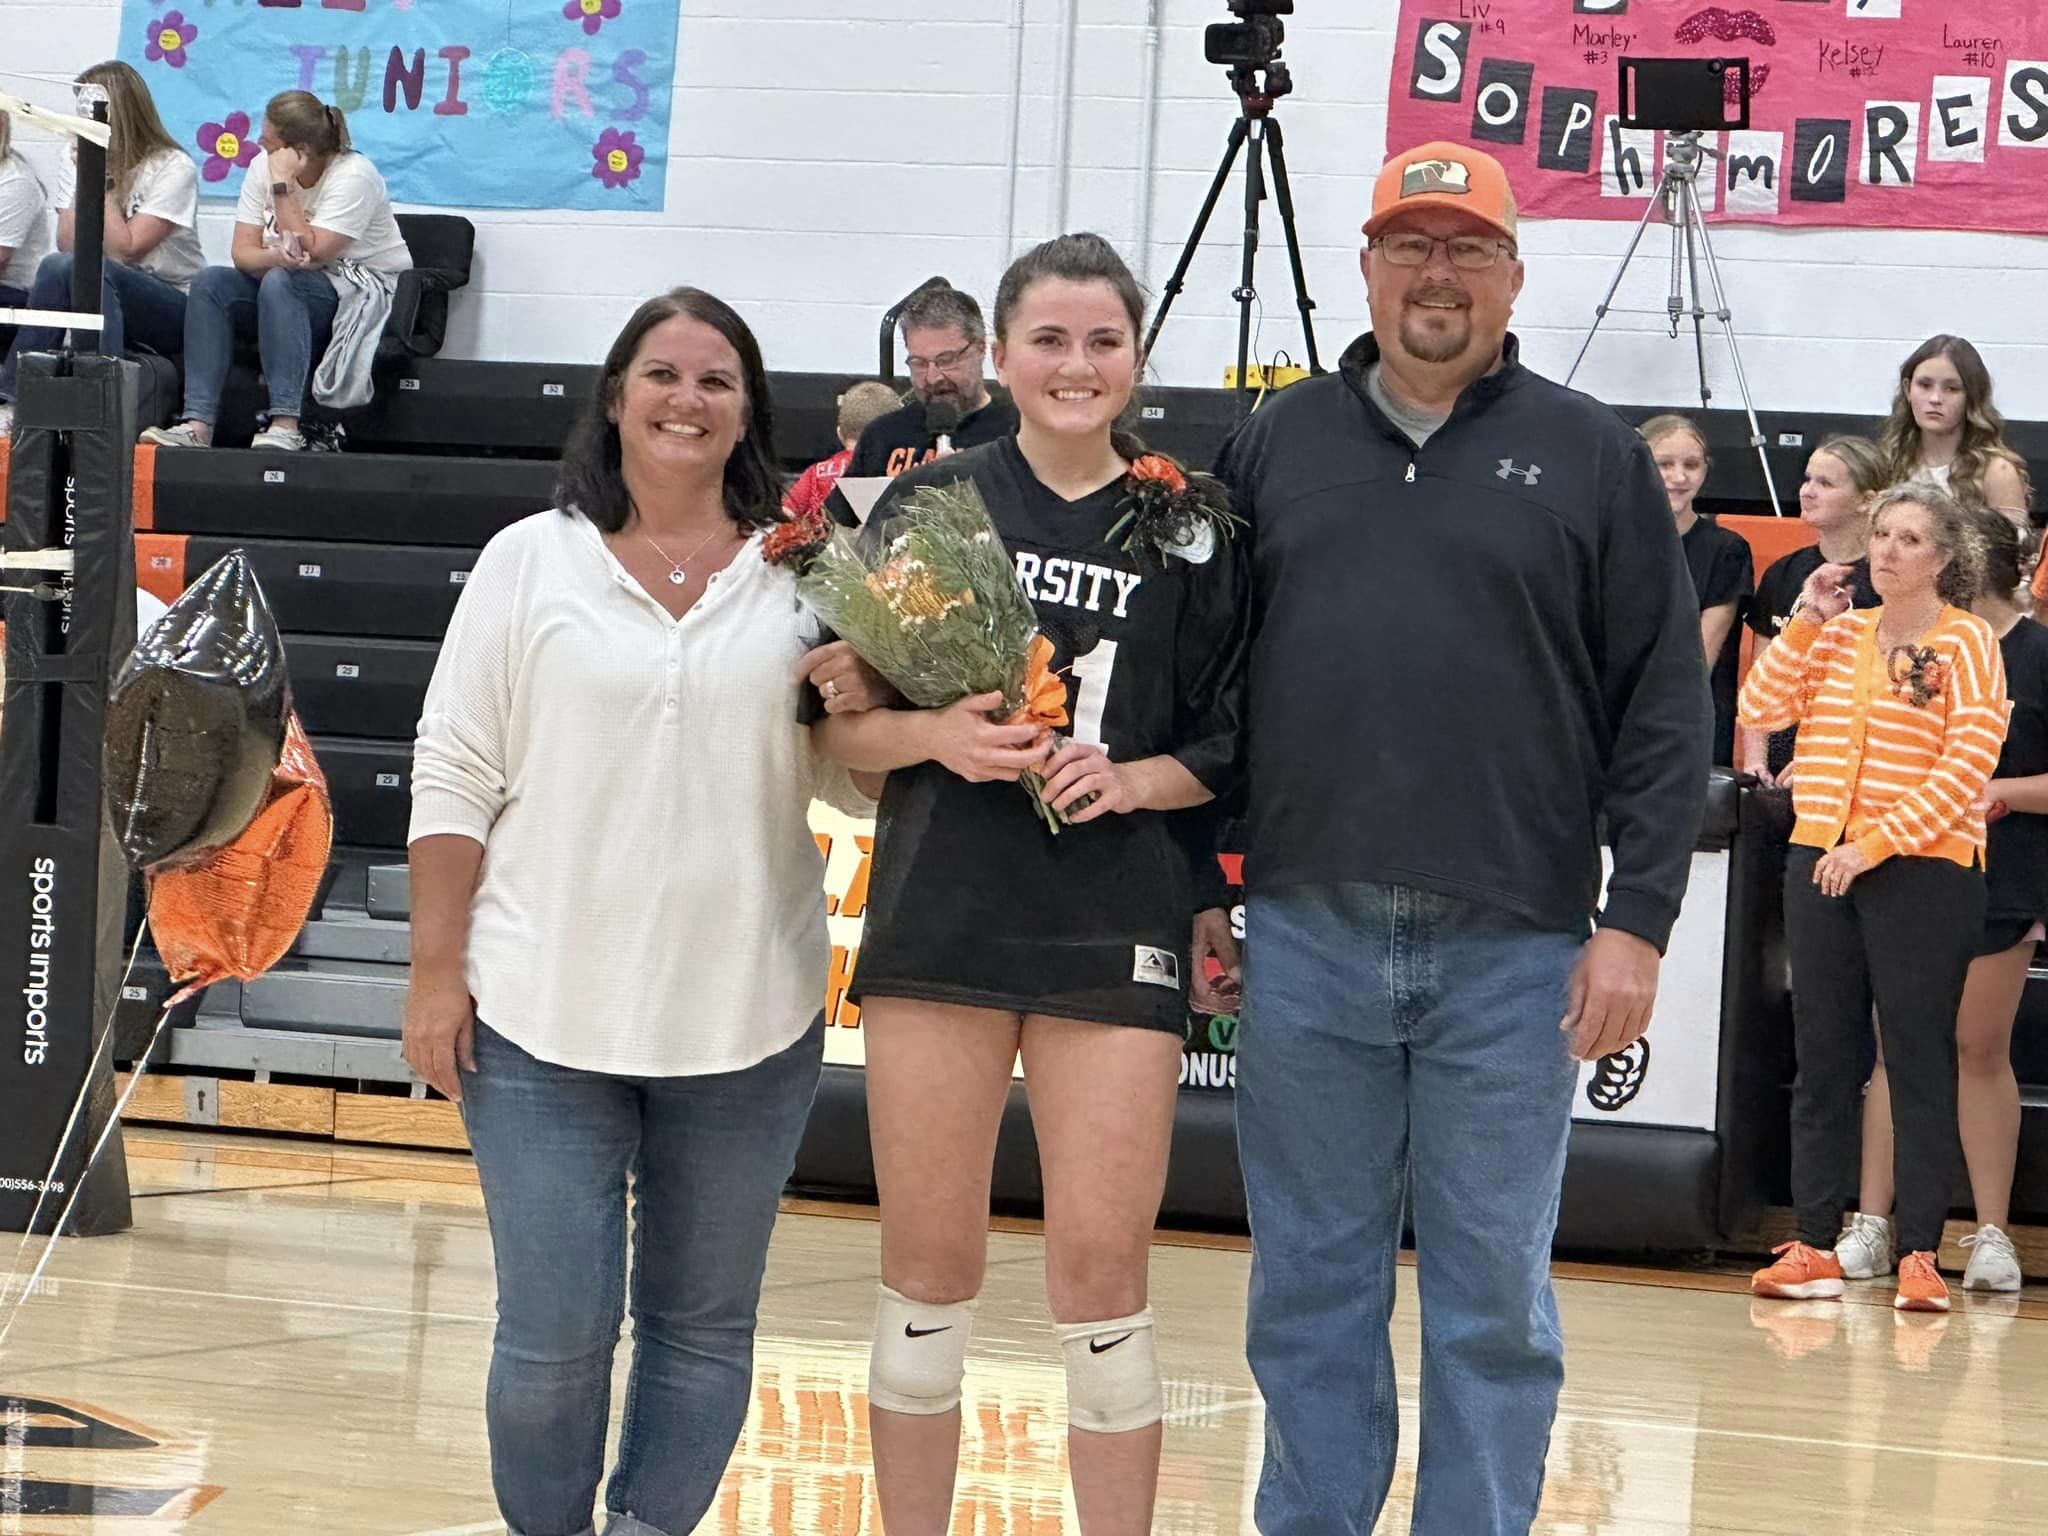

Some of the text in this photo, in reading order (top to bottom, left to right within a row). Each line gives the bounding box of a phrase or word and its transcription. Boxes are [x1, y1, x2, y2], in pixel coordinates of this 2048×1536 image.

[1943, 24, 2003, 49] Lauren
[1584, 51, 1608, 65] #3
[1819, 39, 1884, 72] Kelsey
[1961, 52, 1995, 68] #10
[23, 857, 56, 1065] sports imports
